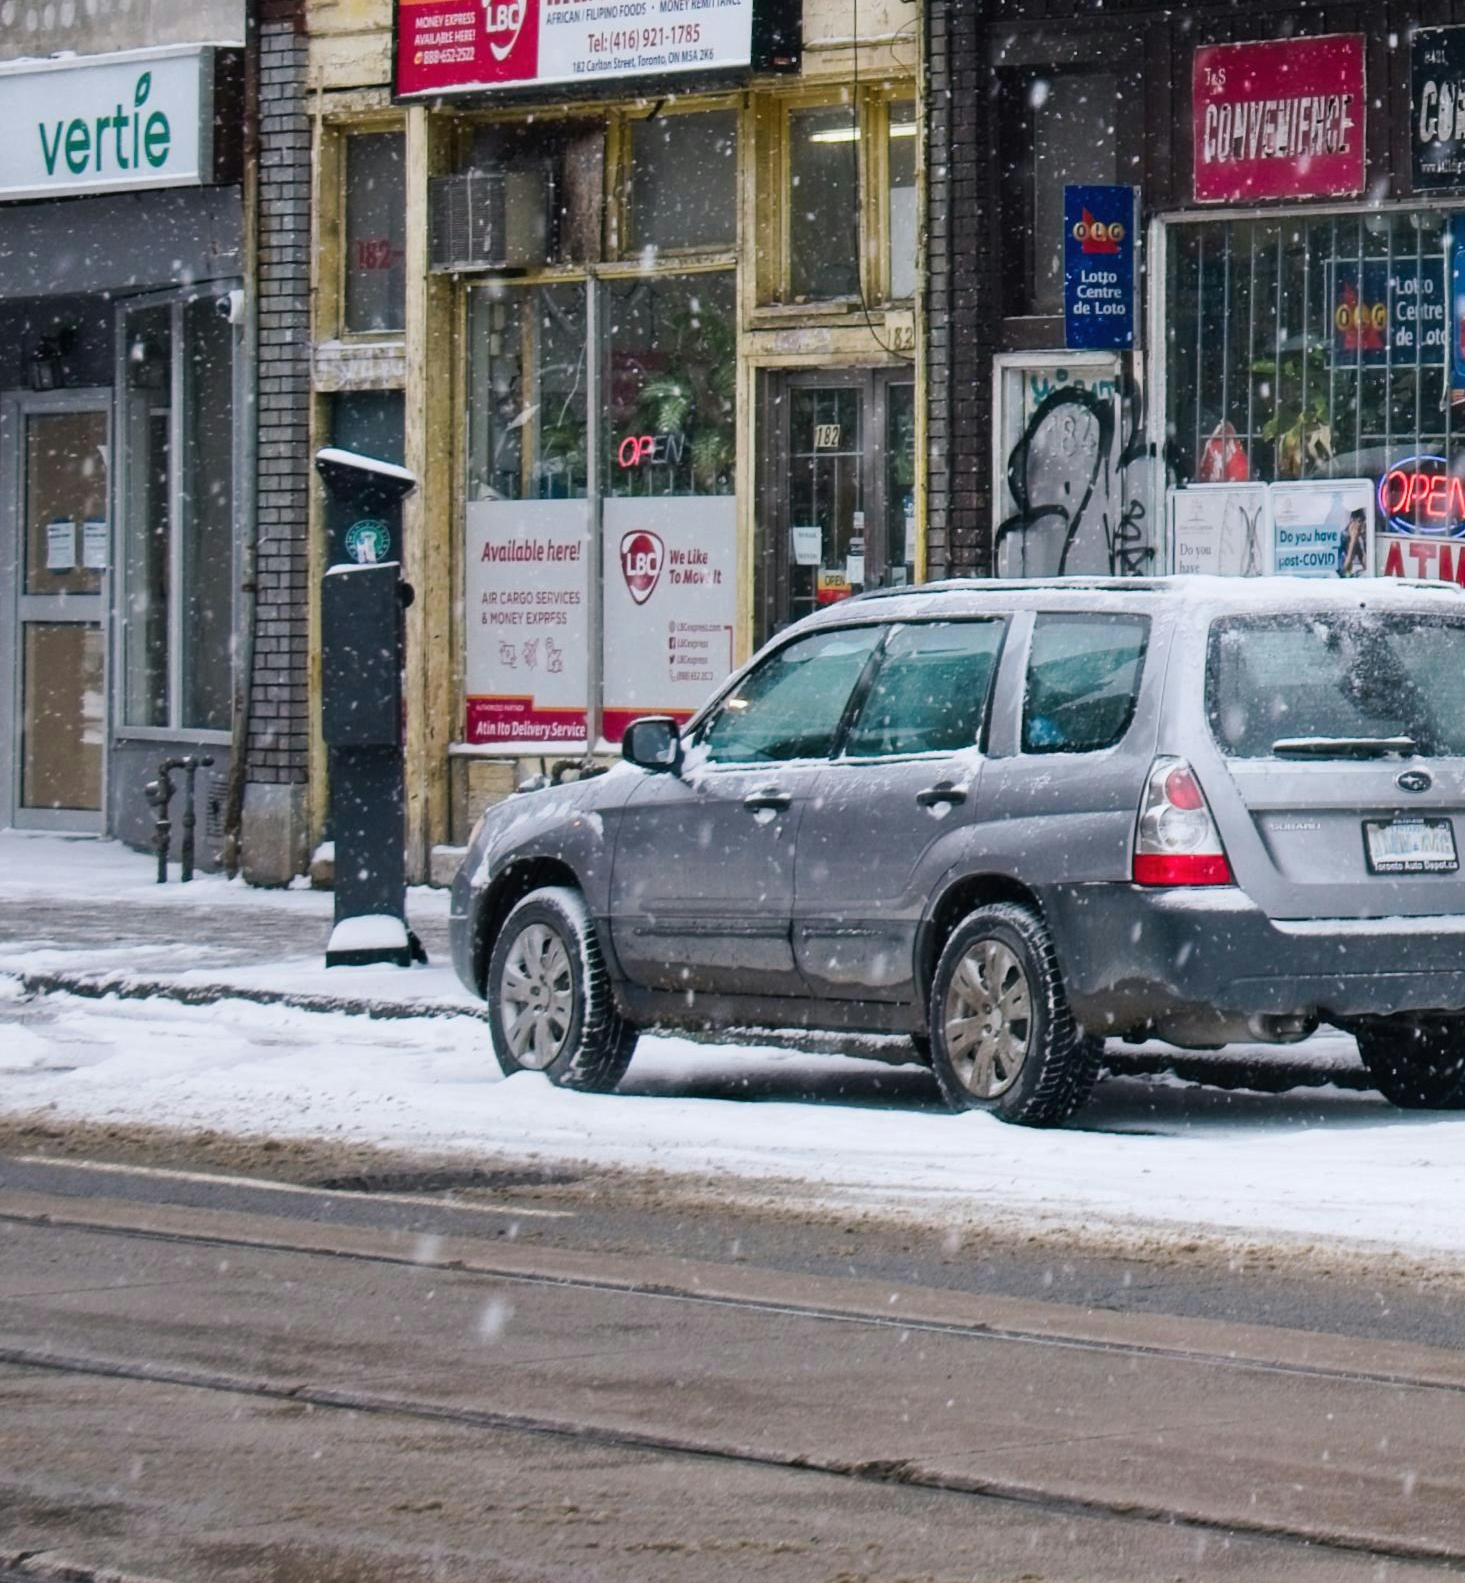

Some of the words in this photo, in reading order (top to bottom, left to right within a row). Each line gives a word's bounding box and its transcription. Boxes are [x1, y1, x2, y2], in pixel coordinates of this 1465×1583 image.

[415, 14, 441, 29] MONEY
[444, 11, 476, 27] EXPRESS
[486, 2, 520, 33] LBC
[546, 9, 580, 25] AFRICAN
[586, 6, 618, 21] FILIPINO
[619, 2, 646, 18] FOODS
[414, 32, 452, 46] AVAILABLE
[452, 28, 476, 43] HERE!
[588, 34, 608, 54] Tel:
[609, 29, 640, 52] (416)
[642, 24, 701, 47] 921-1785
[573, 61, 586, 74] 182
[586, 57, 611, 72] Carlton
[669, 52, 680, 64] ON
[699, 48, 714, 60] 2K6
[39, 72, 171, 177] vertie
[1204, 93, 1354, 165] CONVENIENCE
[1072, 221, 1125, 242] OLG
[1081, 270, 1118, 285] Lotto
[1076, 285, 1122, 299] Centre
[1073, 302, 1090, 315] de
[1095, 301, 1126, 315] Loto
[1395, 325, 1413, 347] de
[815, 425, 840, 447] 182
[618, 431, 686, 467] OPEN
[1280, 529, 1293, 544] Do
[1296, 531, 1313, 547] you
[1314, 528, 1337, 542] have
[481, 538, 544, 563] Available
[547, 538, 581, 562] here!
[669, 549, 686, 565] We
[687, 549, 708, 564] Like
[1180, 543, 1194, 555] Do
[1196, 545, 1211, 559] you
[626, 552, 659, 577] LBC
[1179, 562, 1200, 574] have
[1278, 553, 1336, 571] post-COVID
[669, 569, 681, 584] To
[713, 569, 722, 584] It
[482, 591, 498, 605] AIR
[500, 591, 534, 605] CARGO
[536, 590, 581, 605] SERVICES
[490, 611, 524, 625] MONEY
[526, 611, 567, 625] EXPRESS
[476, 721, 496, 736] Atin
[496, 721, 511, 735] Ito
[511, 720, 551, 740] Delivery
[551, 721, 586, 737] Service
[1269, 822, 1321, 831] SUBARU
[1374, 861, 1403, 872] Toronto
[1404, 860, 1423, 871] Auto
